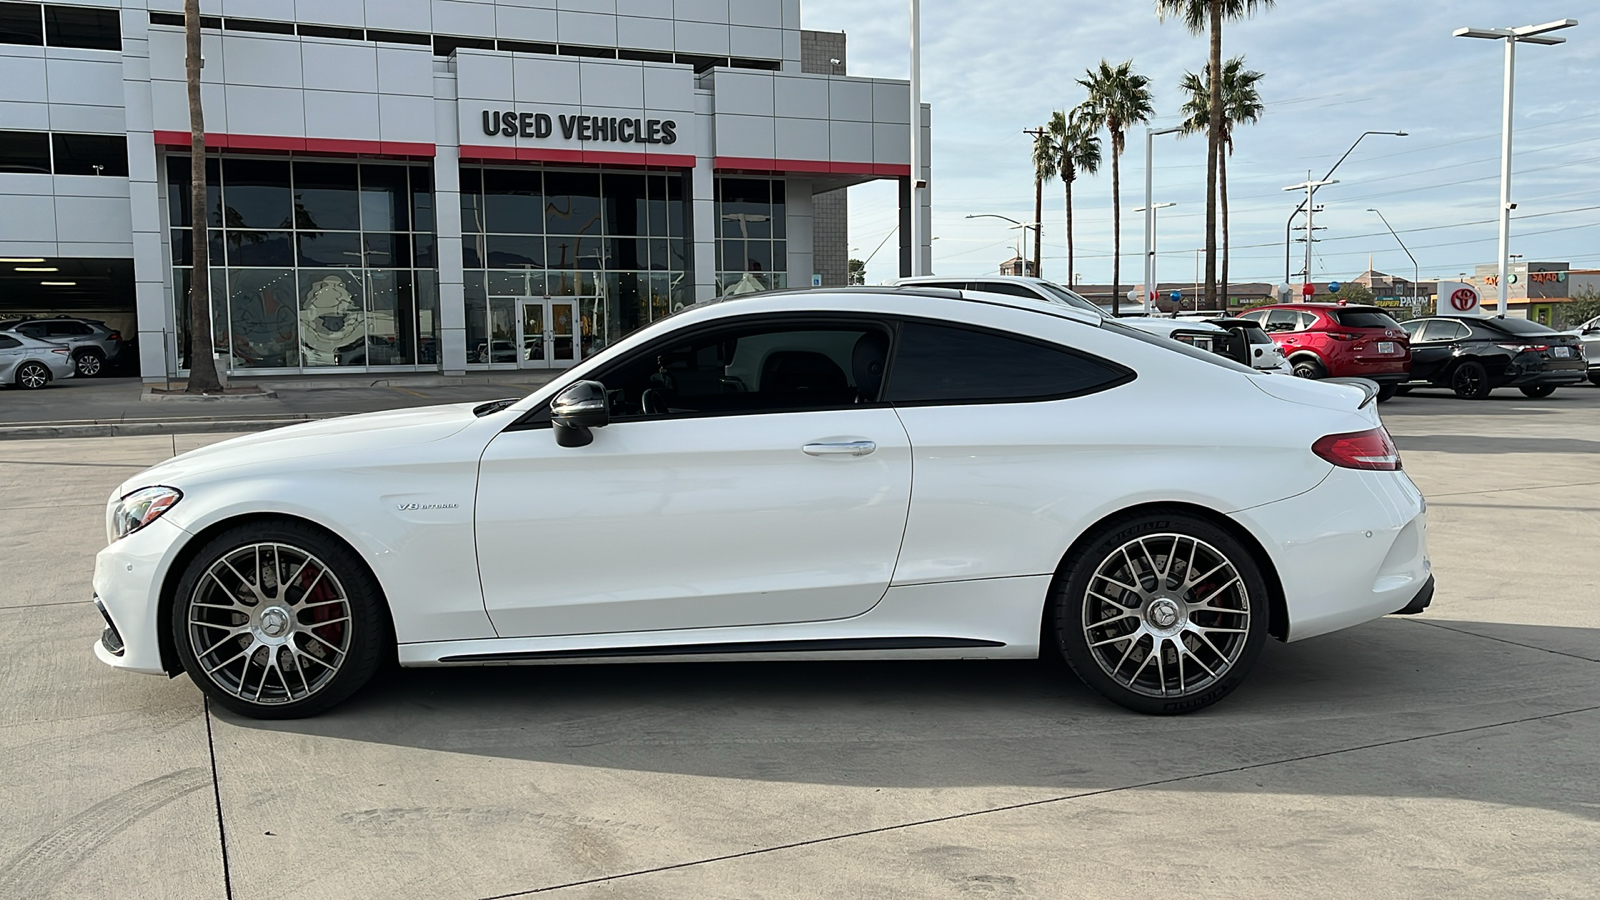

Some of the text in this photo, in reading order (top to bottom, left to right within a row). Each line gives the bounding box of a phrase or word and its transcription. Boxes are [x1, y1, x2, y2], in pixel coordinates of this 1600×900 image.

[482, 110, 677, 145] USED VEHICLES
[1400, 296, 1428, 307] PAWN
[397, 502, 420, 511] V8
[1107, 521, 1169, 543] MICHELIN
